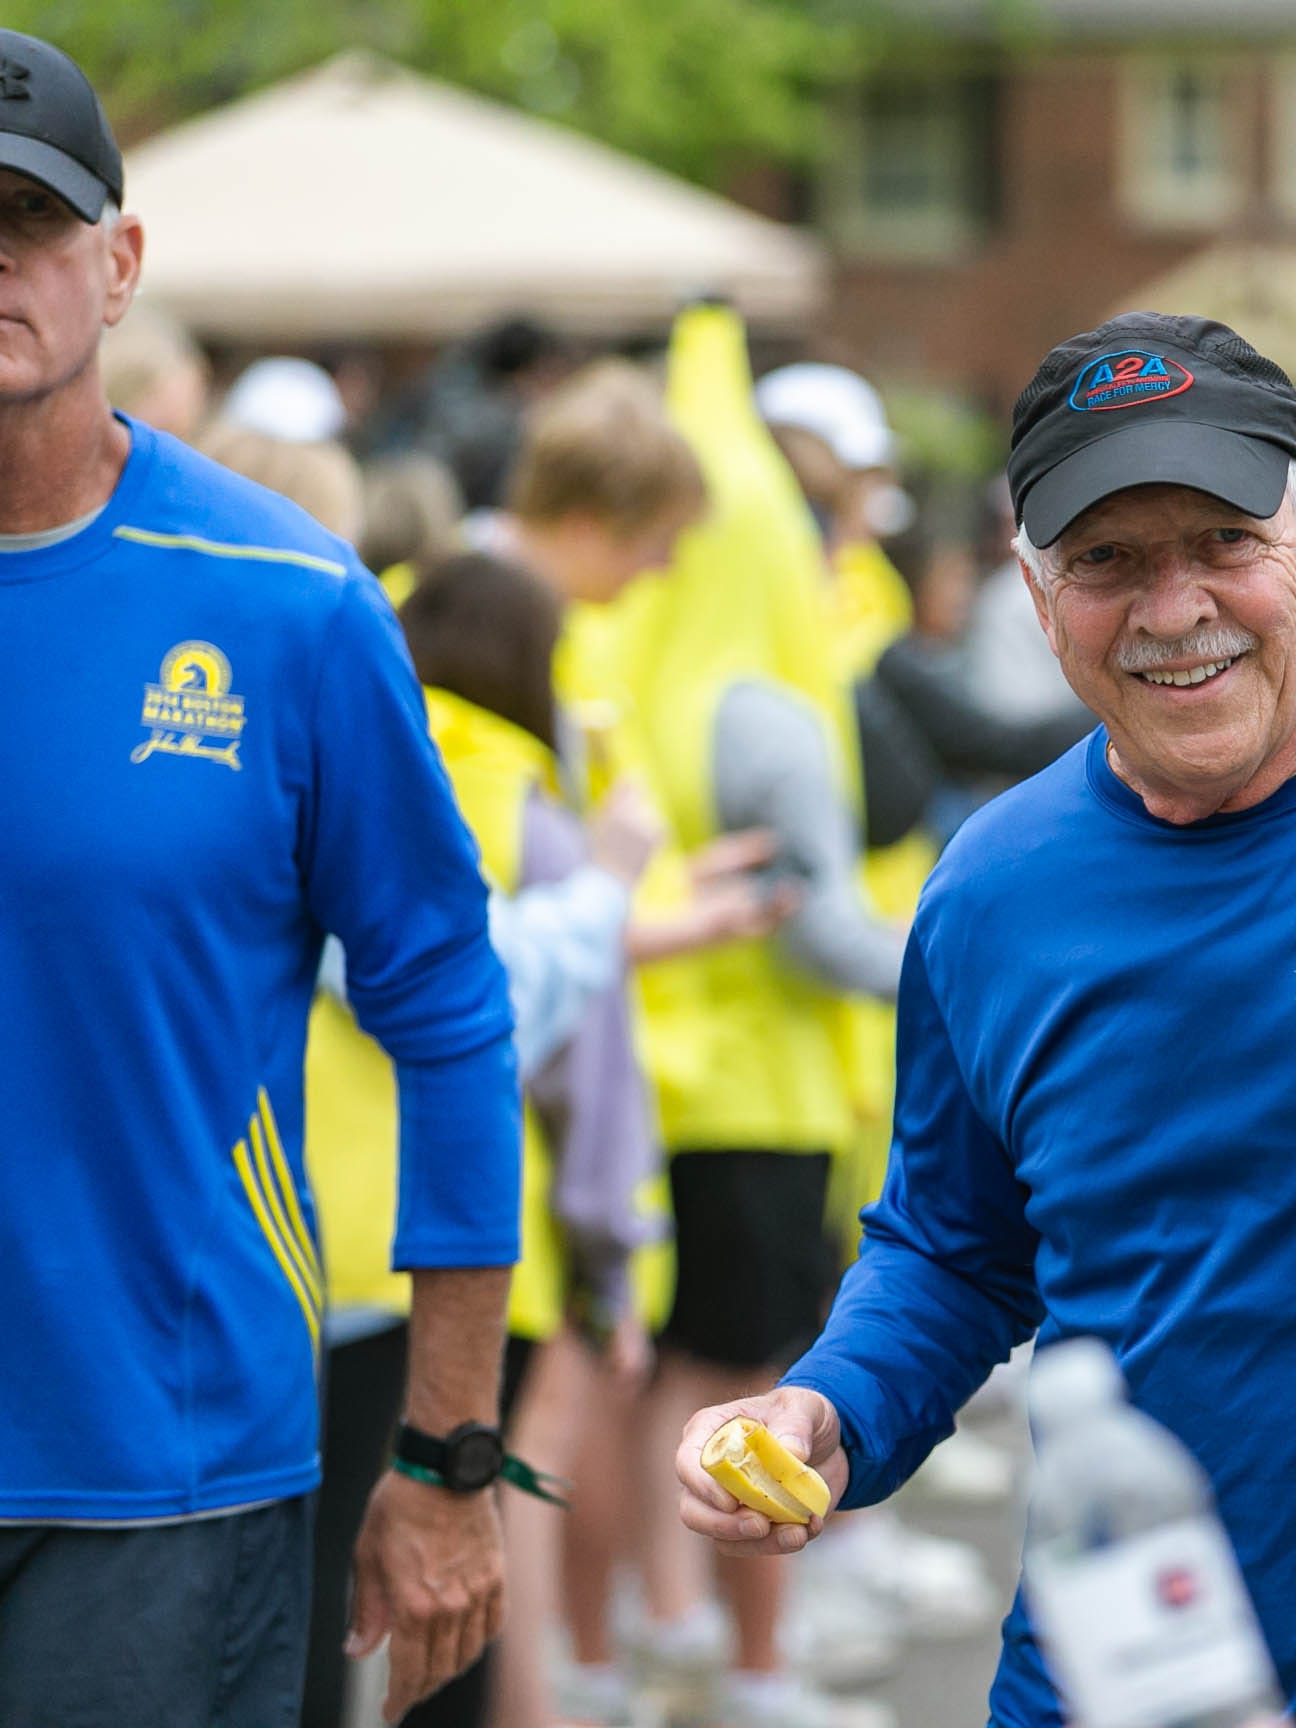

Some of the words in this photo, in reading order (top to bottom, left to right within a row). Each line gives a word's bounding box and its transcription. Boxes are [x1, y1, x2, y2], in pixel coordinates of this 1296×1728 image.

[1088, 357, 1168, 390] A2A
[1087, 390, 1112, 408] RACE
[1113, 385, 1134, 399] FOR
[1134, 381, 1171, 394] MERCY
